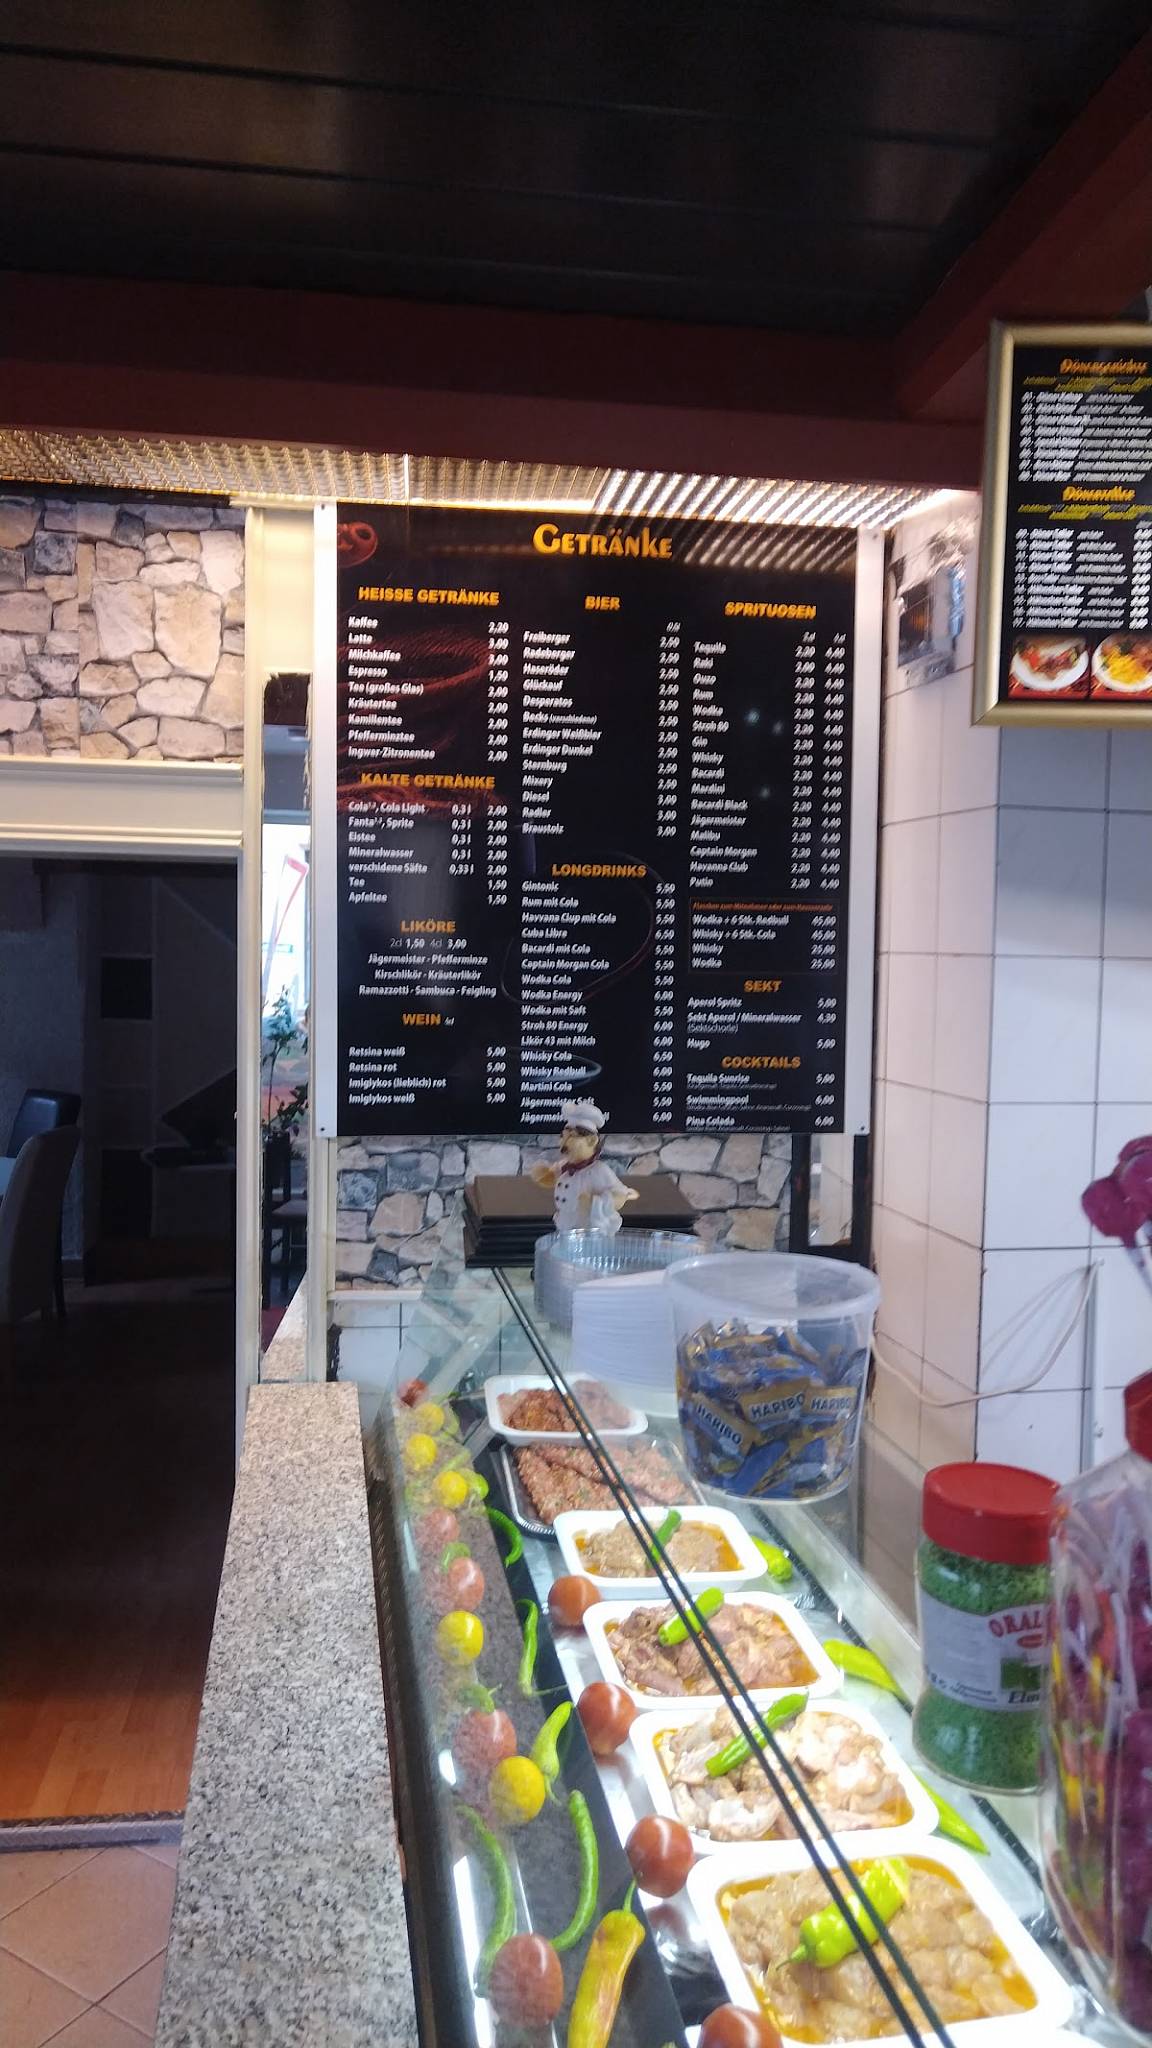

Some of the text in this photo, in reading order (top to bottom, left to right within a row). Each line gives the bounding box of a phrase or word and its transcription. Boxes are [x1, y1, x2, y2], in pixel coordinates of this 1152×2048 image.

[359, 587, 500, 605] HEISSE GETRÄNKE
[584, 595, 621, 611] BIER
[348, 616, 509, 634] Kaffee 2,20
[348, 633, 372, 644] Latte
[523, 631, 570, 645] Freiberger
[348, 649, 401, 662] Milchkaffee
[523, 647, 575, 662] Radeberger
[348, 665, 508, 682] Espresso 1,50
[348, 682, 364, 693] Tee
[401, 682, 423, 695] Glas)
[523, 679, 563, 691] Glückauf
[348, 698, 508, 714] Kräutertee 2,00
[348, 714, 508, 730] Kamillentee 2,00
[523, 711, 548, 723] Becks
[348, 730, 508, 746] Pfefferminztee 2,00
[522, 727, 561, 741] Erdinger
[348, 746, 507, 762] Ingwer-Zitronentee 2,00
[522, 743, 593, 757] Erdinger Dunkel
[522, 759, 567, 773] Sternburg
[692, 768, 724, 779] Bacardi
[361, 773, 495, 789] KALTE GETRÄNKE
[522, 775, 553, 788] Mixery
[522, 791, 549, 802] Diesel
[380, 802, 400, 812] Cola
[487, 805, 507, 817] 2,00
[691, 799, 724, 810] Bacardi
[522, 807, 551, 818] Radler
[387, 817, 507, 831] Sprite 2,00
[690, 815, 746, 827] Jägermeister
[522, 823, 564, 834] Braustolz
[349, 832, 507, 846] Eistee 2,00
[349, 847, 507, 861] Mineralwasser 2,00
[404, 863, 427, 874] Säfte
[487, 865, 507, 876] 2,00
[552, 864, 647, 877] LONGDRINKS
[349, 877, 507, 891] Tee 1,50
[522, 881, 559, 892] Gintonic
[349, 892, 507, 906] Apfeltee 1,50
[522, 897, 578, 908] Rum mit Cola
[582, 914, 596, 923] mit
[597, 913, 617, 924] Cola
[400, 919, 456, 933] LIKÖRE
[522, 928, 567, 939] Cuba Libre
[405, 939, 424, 949] 1,50
[447, 939, 466, 949] 3,00
[522, 944, 590, 954] Bacardi mit Cola
[368, 954, 488, 965] Jägermeister Pfefferminze
[522, 959, 609, 971] Captain Morgan Cola
[375, 969, 481, 980] Kirschlikör Kräuterlikör
[522, 974, 571, 985] Wodka Cola
[359, 985, 496, 998] Ramazzotti Sambuca Feigling
[744, 980, 782, 992] SEKT
[521, 990, 582, 1002] Wodka Energy
[687, 997, 716, 1009] Aperol
[521, 1005, 586, 1016] Wodka mit Saft
[402, 1013, 441, 1025] WEIN
[521, 1021, 588, 1032] Stroh 80 Energy
[521, 1036, 595, 1046] Likör 43 mit Milch
[687, 1038, 710, 1050] Hugo
[349, 1047, 382, 1057] Retsina
[384, 1047, 405, 1057] weiß
[521, 1051, 572, 1063] Whisky Cola
[349, 1063, 382, 1072] Retsina
[384, 1063, 397, 1072] rot
[722, 1056, 801, 1069] COCKTAILS
[521, 1067, 552, 1078] Whisky
[687, 1073, 718, 1084] Tequila
[433, 1079, 446, 1088] rot
[520, 1082, 572, 1092] Martini Cola
[393, 1094, 415, 1103] weiß
[750, 1392, 805, 1419] HARIBO
[811, 1398, 850, 1410] HARIBO
[696, 1405, 743, 1445] HARIBO
[989, 1611, 1042, 1638] ORAL
